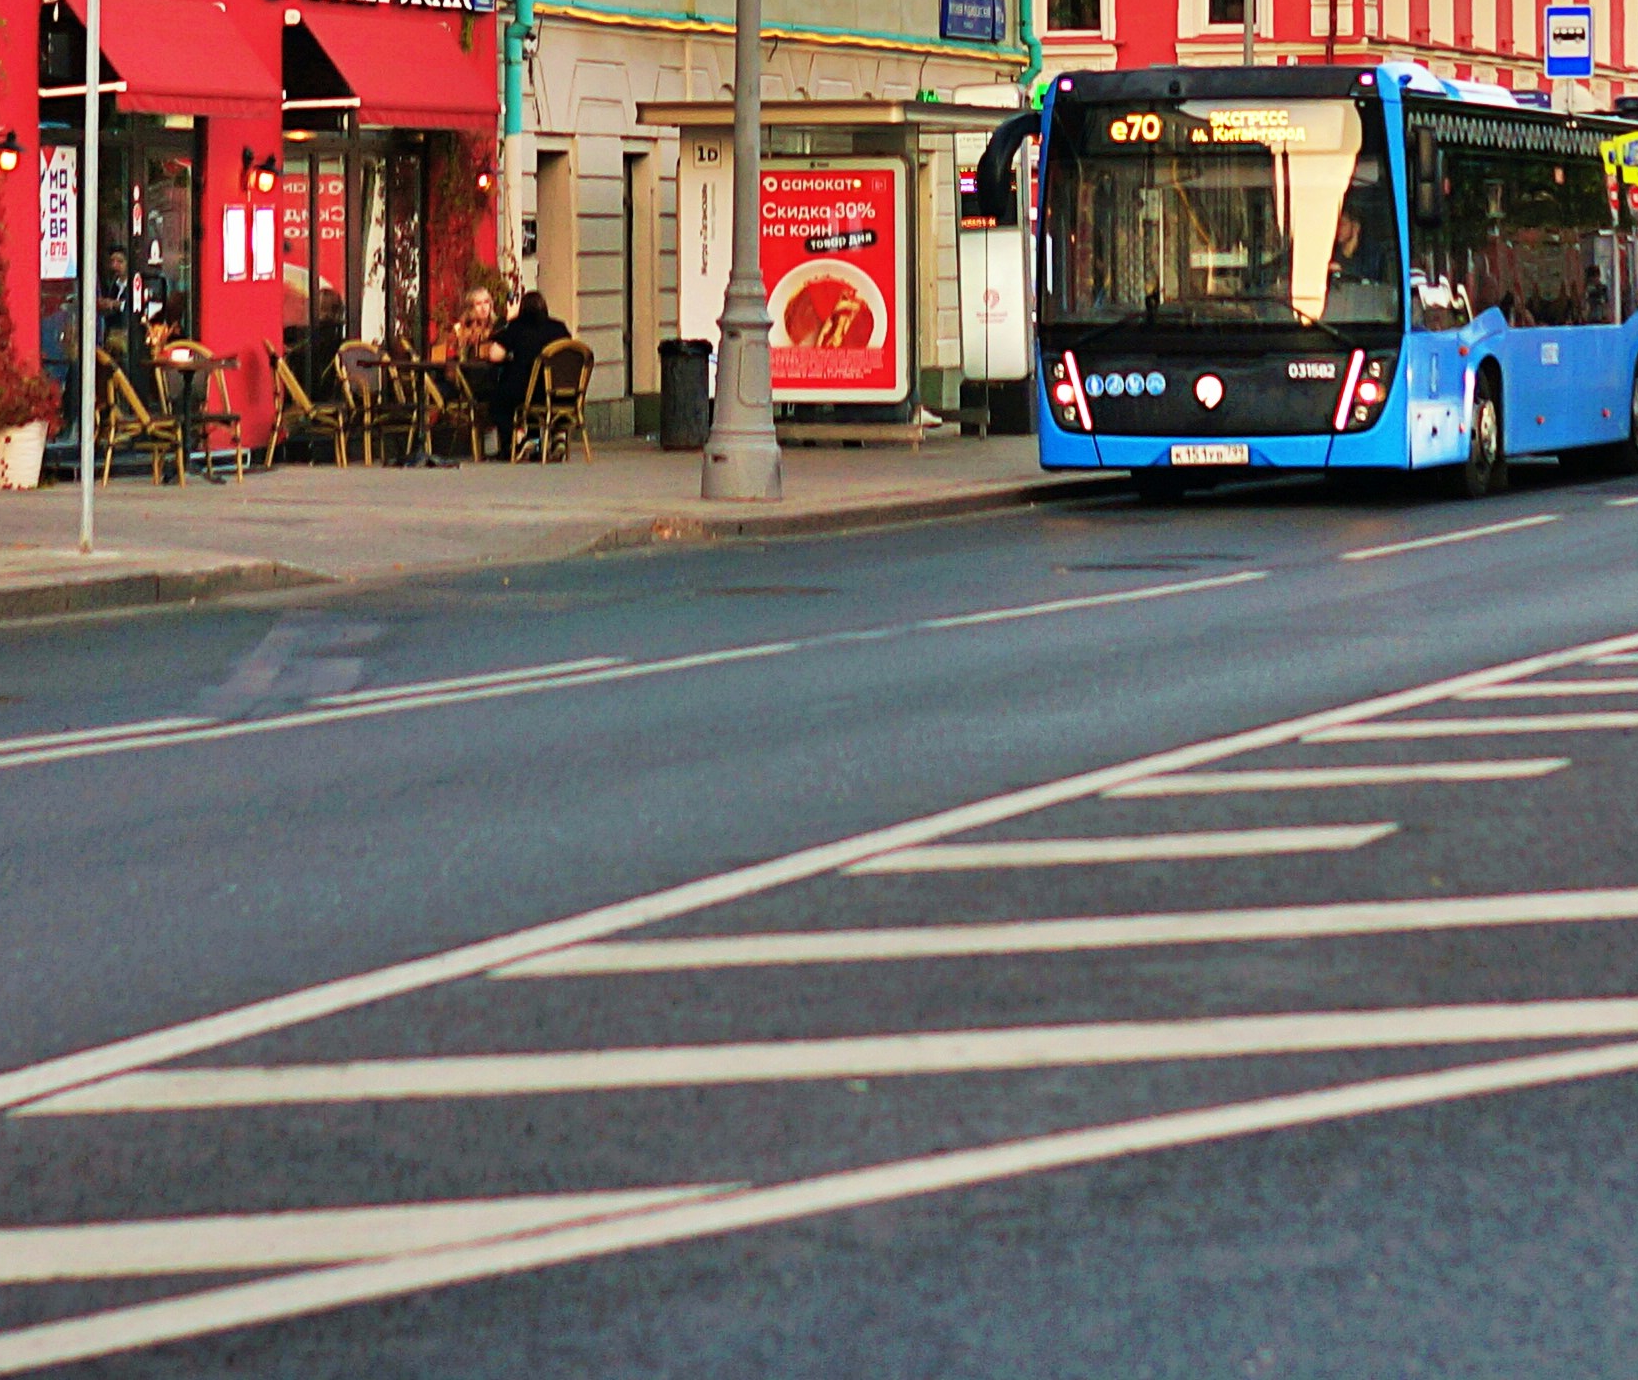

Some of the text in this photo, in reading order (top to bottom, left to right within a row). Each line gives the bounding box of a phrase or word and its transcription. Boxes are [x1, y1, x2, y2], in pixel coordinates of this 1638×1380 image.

[1210, 110, 1288, 127] ЭКСПРЕСС
[781, 178, 852, 191] самокат
[762, 201, 876, 220] Скидка 30%
[763, 223, 832, 237] на коин
[810, 232, 872, 251] товар дня
